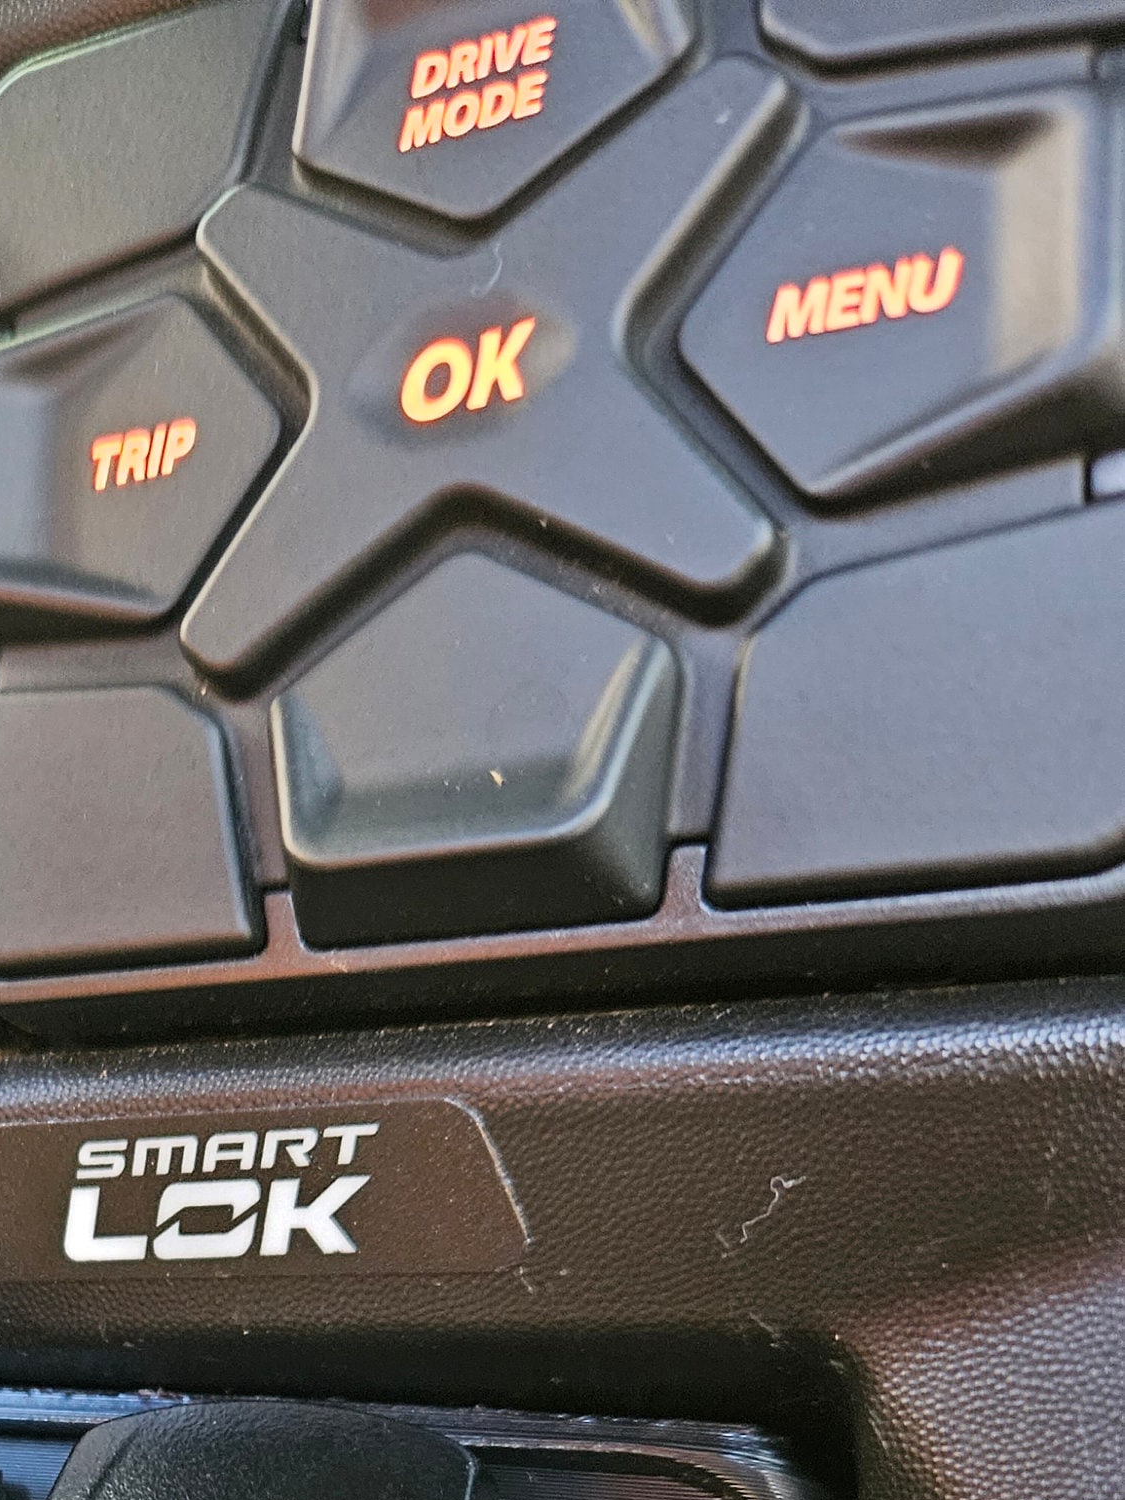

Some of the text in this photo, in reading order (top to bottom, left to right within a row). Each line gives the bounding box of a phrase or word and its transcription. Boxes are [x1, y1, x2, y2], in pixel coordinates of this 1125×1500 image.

[411, 15, 557, 102] DRIVE
[399, 70, 547, 154] MODE
[765, 247, 963, 344] MENU
[400, 318, 535, 425] OK
[91, 419, 196, 493] TRIP
[76, 1123, 380, 1179] SMART
[63, 1174, 372, 1262] LOK
